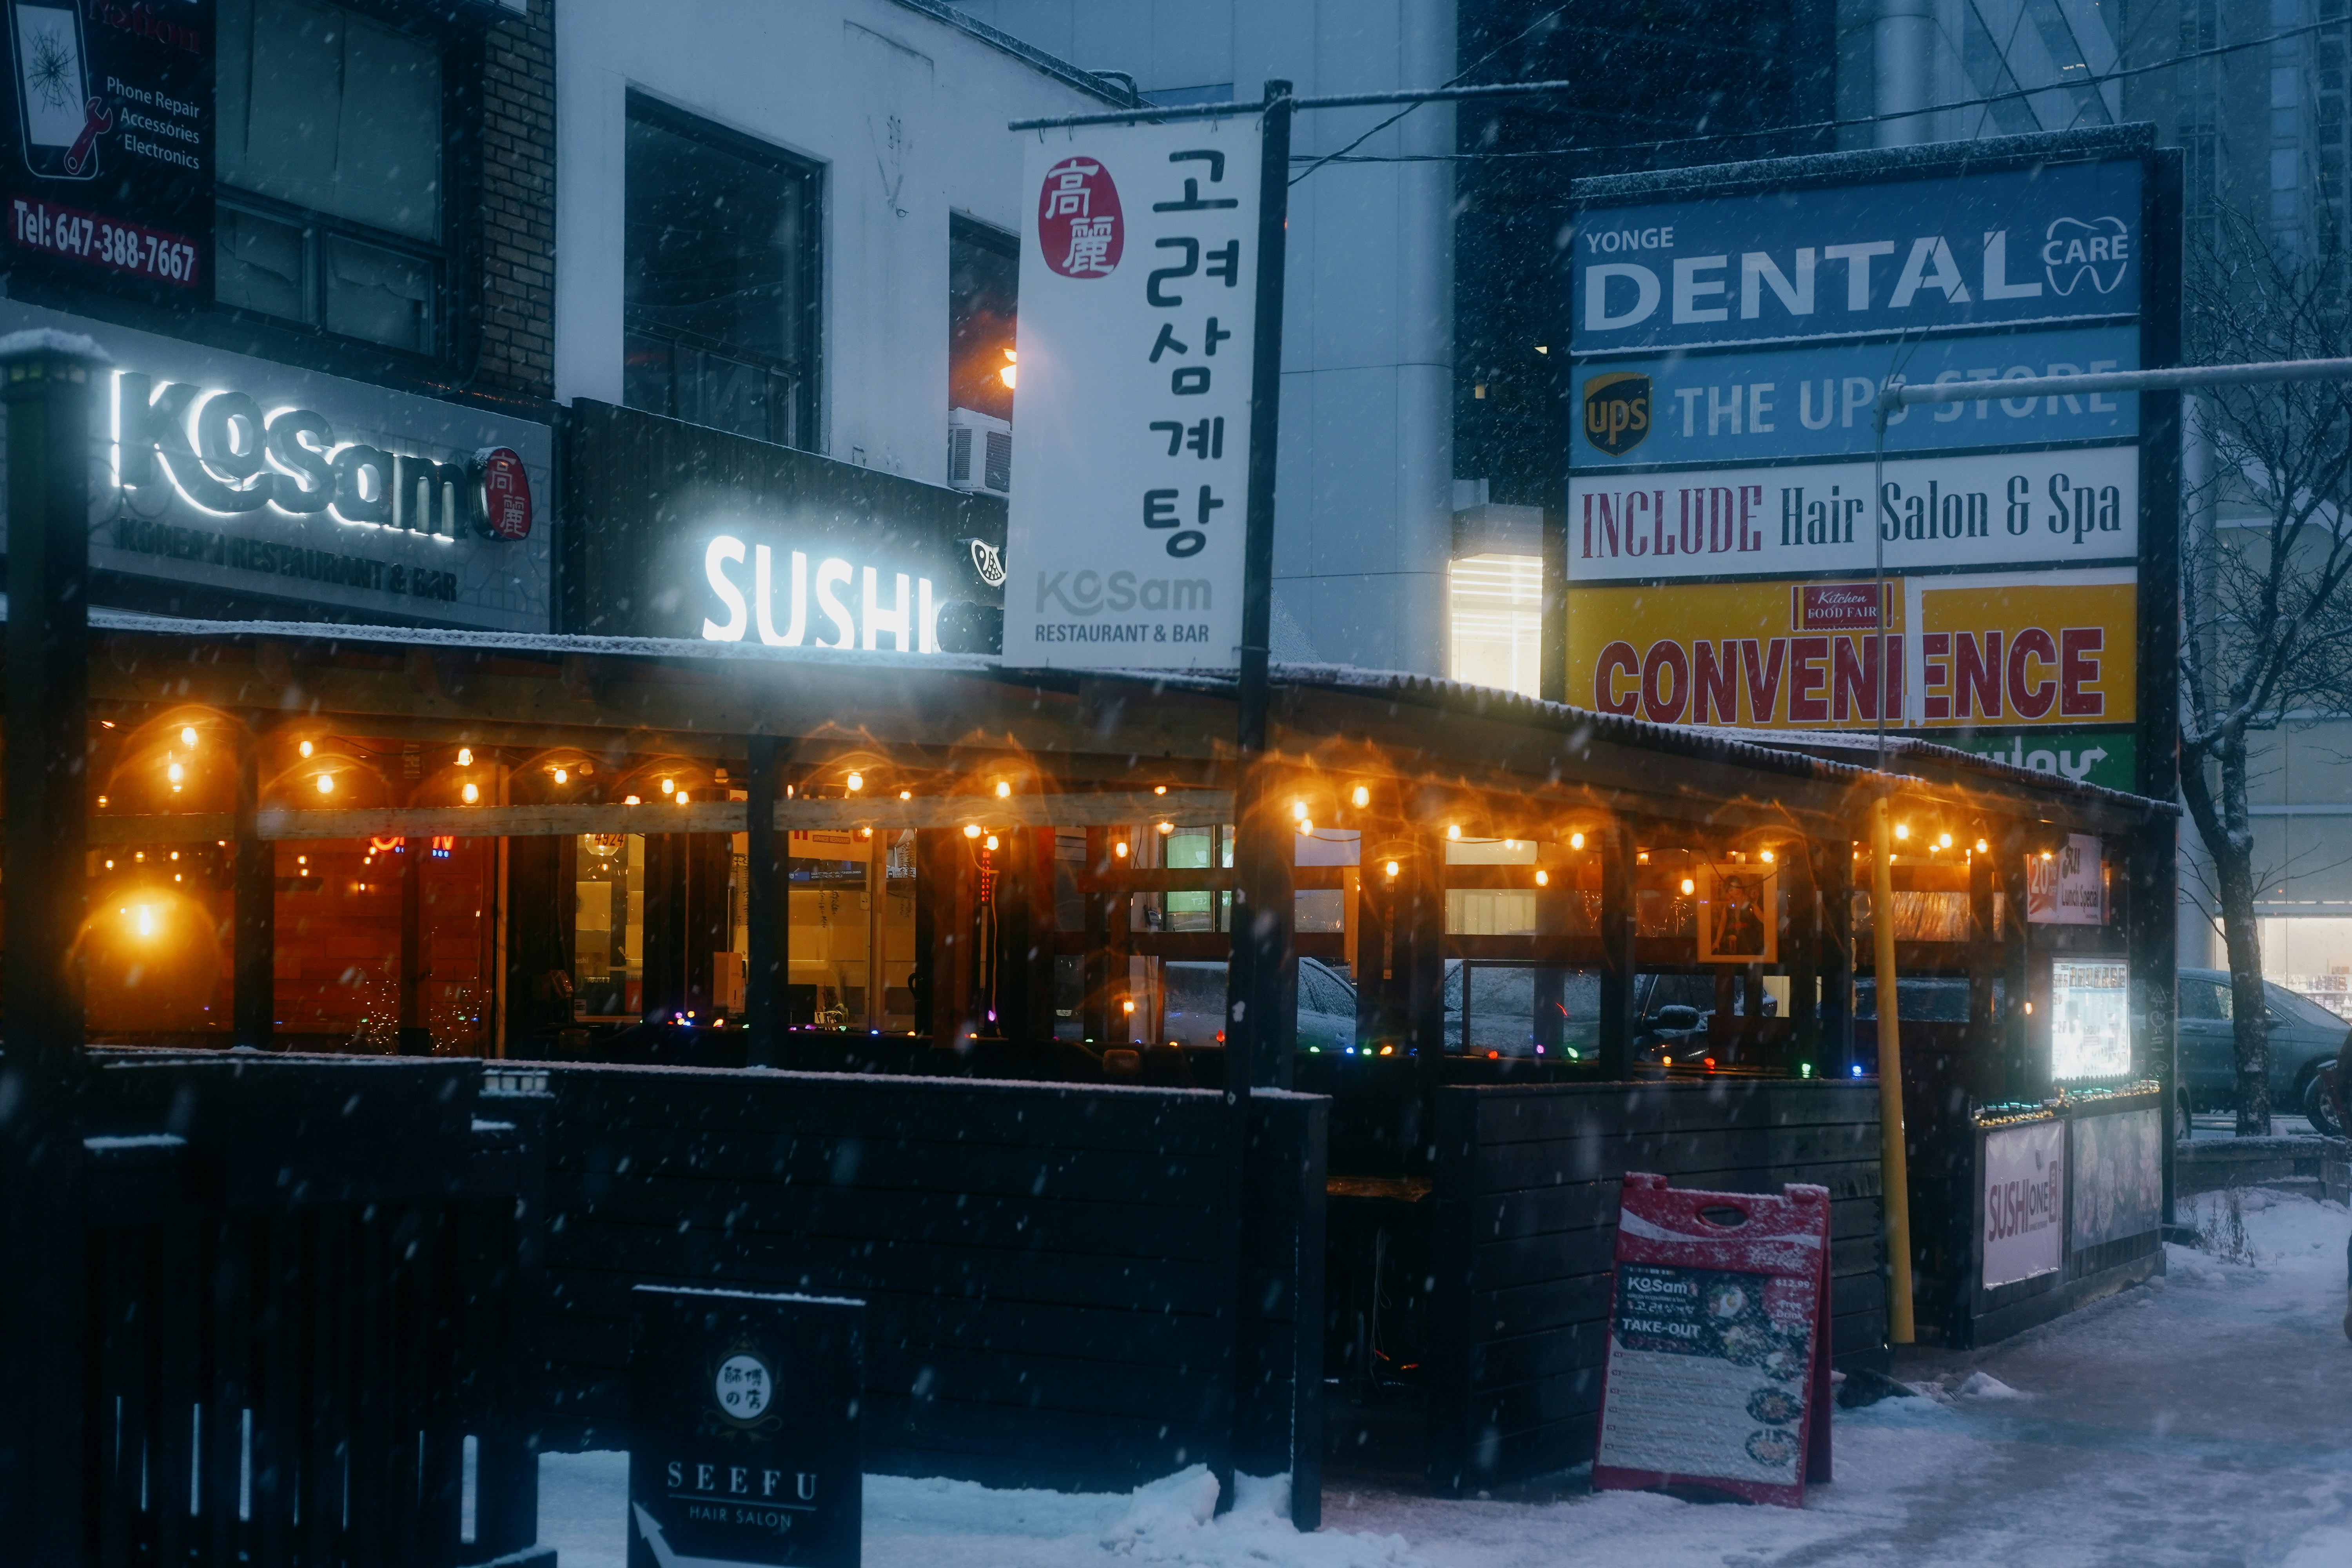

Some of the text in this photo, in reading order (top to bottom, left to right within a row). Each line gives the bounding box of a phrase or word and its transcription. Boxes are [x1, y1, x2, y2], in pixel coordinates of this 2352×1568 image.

[107, 76, 200, 118] Phone Repair
[120, 107, 200, 144] Accessories
[125, 134, 200, 169] Electronics
[14, 200, 194, 281] Tel: 647-388-7667
[1046, 160, 1114, 274] 高麗
[1586, 227, 1674, 253] YONGE
[2043, 235, 2129, 266] CARE
[1584, 230, 2042, 331] DENTAL
[1143, 149, 1239, 558] 고려삼계탕
[1588, 397, 1647, 445] ups
[1675, 382, 1775, 437] THE
[1934, 360, 2117, 423] STORE
[489, 452, 526, 537] 高麗
[1581, 473, 2121, 558] INCLUDE Hair Salon & Spa
[230, 536, 386, 590] RESTAURANT
[413, 566, 457, 602] BAR
[702, 535, 932, 654] SUSHI
[1808, 606, 1877, 619] FOOD FAIR
[1817, 591, 1867, 604] Kitchen
[1035, 624, 1209, 642] RESTAURANT & BAR
[1594, 627, 2105, 724] CONVENIENCE
[1989, 1179, 2029, 1242] SUSHI
[2029, 1182, 2048, 1216] ONE
[1622, 1318, 1702, 1339] TAKE-OUT
[667, 1461, 817, 1500] SEEFU
[689, 1505, 792, 1528] HAIR SALON
